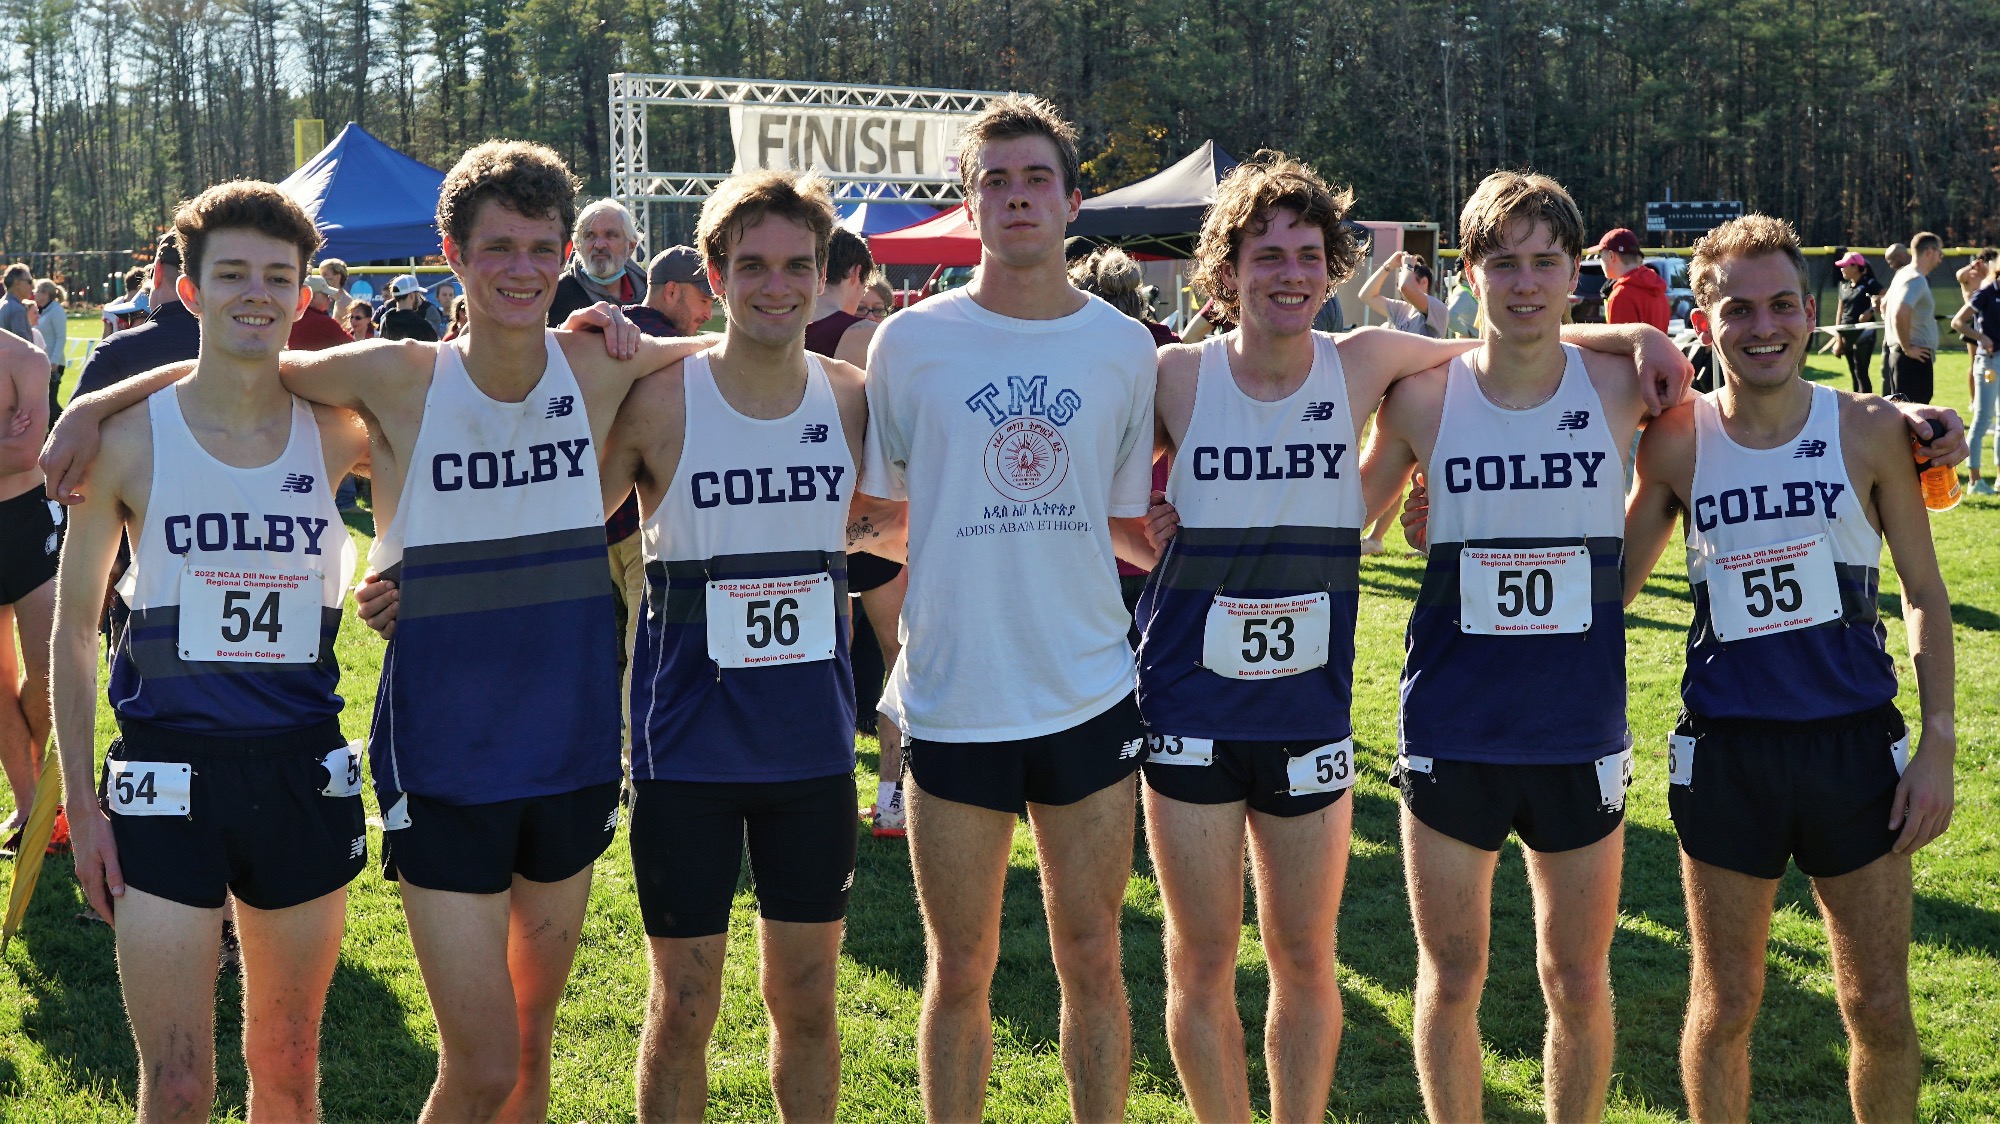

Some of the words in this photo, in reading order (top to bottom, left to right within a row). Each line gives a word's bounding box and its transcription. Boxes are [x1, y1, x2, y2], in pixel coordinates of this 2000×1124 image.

[758, 113, 926, 174] FINISH
[965, 375, 1082, 427] TMS
[432, 437, 590, 492] COLBY
[1193, 443, 1347, 481] COLBY
[1445, 452, 1606, 494] COLBY
[691, 465, 845, 509] COLBY
[1695, 480, 1845, 533] COLBY
[164, 512, 329, 556] COLBY
[956, 523, 995, 538] ADDIS
[1038, 520, 1092, 533] ETHIOPI
[1515, 559, 1566, 567] Championship
[1546, 550, 1576, 558] England
[1715, 556, 1729, 565] 2022
[1730, 553, 1752, 562] NCAA
[1768, 548, 1784, 556] New
[1786, 540, 1816, 552] England
[1723, 560, 1754, 571] Regional
[1755, 550, 1808, 565] Championship
[194, 570, 216, 578] 2022
[217, 571, 241, 579] NCAA
[206, 579, 241, 588] Regional
[243, 580, 299, 589] Championship
[793, 578, 820, 587] England
[729, 590, 761, 598] Regional
[763, 586, 811, 596] Championship
[1218, 600, 1236, 608] 2022
[1291, 598, 1318, 607] England
[1497, 568, 1554, 618] 50
[1742, 563, 1803, 618] 55
[221, 590, 283, 643] 54
[746, 597, 800, 649] 56
[1260, 606, 1309, 616] Championship
[1530, 623, 1559, 631] College
[1748, 623, 1782, 634] Bowdoin
[1783, 616, 1813, 627] College
[1241, 616, 1295, 663] 53
[216, 650, 253, 658] Bowdoin
[254, 651, 286, 659] College
[744, 655, 778, 664] Bowdoin
[779, 652, 806, 660] College
[1271, 667, 1298, 675] College
[346, 753, 362, 786] 5
[1315, 750, 1349, 784] 53
[115, 771, 157, 805] 54
[889, 790, 902, 810] NIKE
